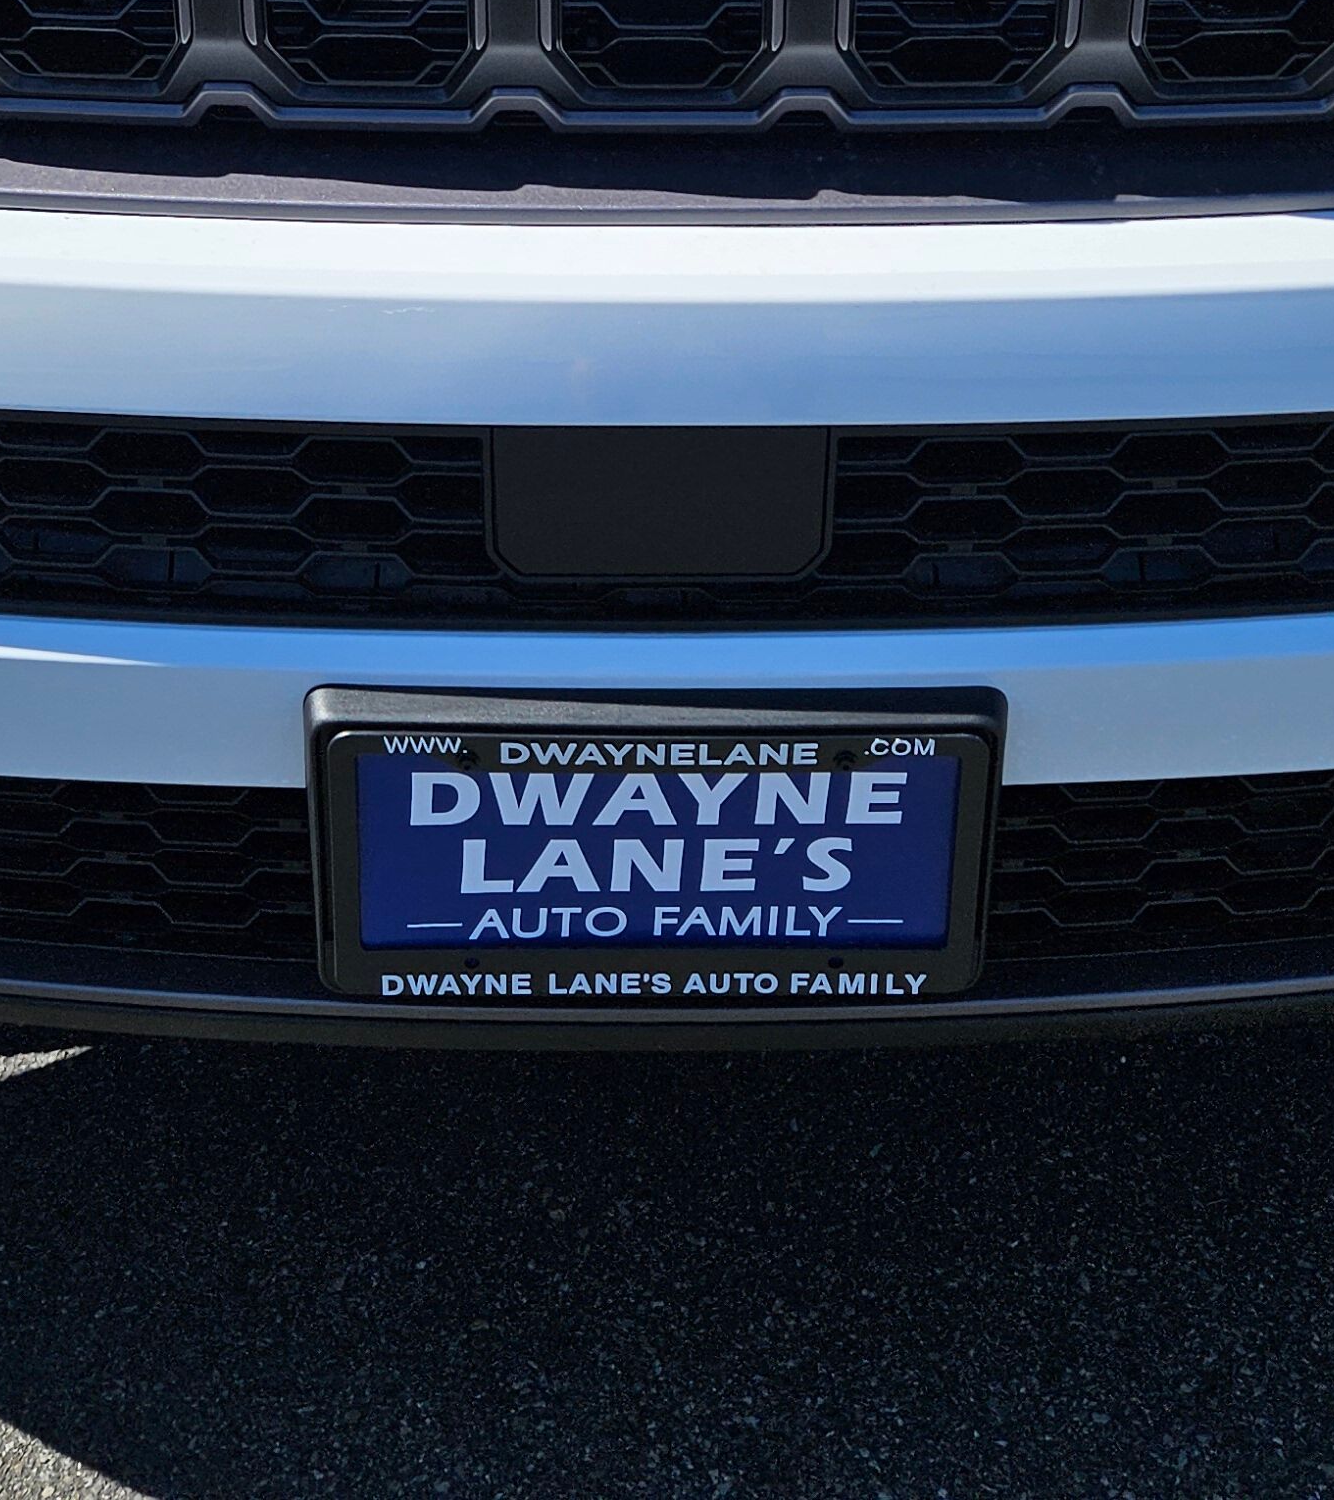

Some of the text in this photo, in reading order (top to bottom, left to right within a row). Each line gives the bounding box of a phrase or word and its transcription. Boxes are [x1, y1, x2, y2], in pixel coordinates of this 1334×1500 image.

[384, 735, 936, 766] WWW. DWAYNELANE .COM
[409, 771, 908, 826] DWAYNE
[460, 837, 853, 894] LANE'S
[469, 905, 843, 940] AUTO FAMILY
[381, 973, 928, 996] DWAYNE LANE'S AUTO FAMILY
